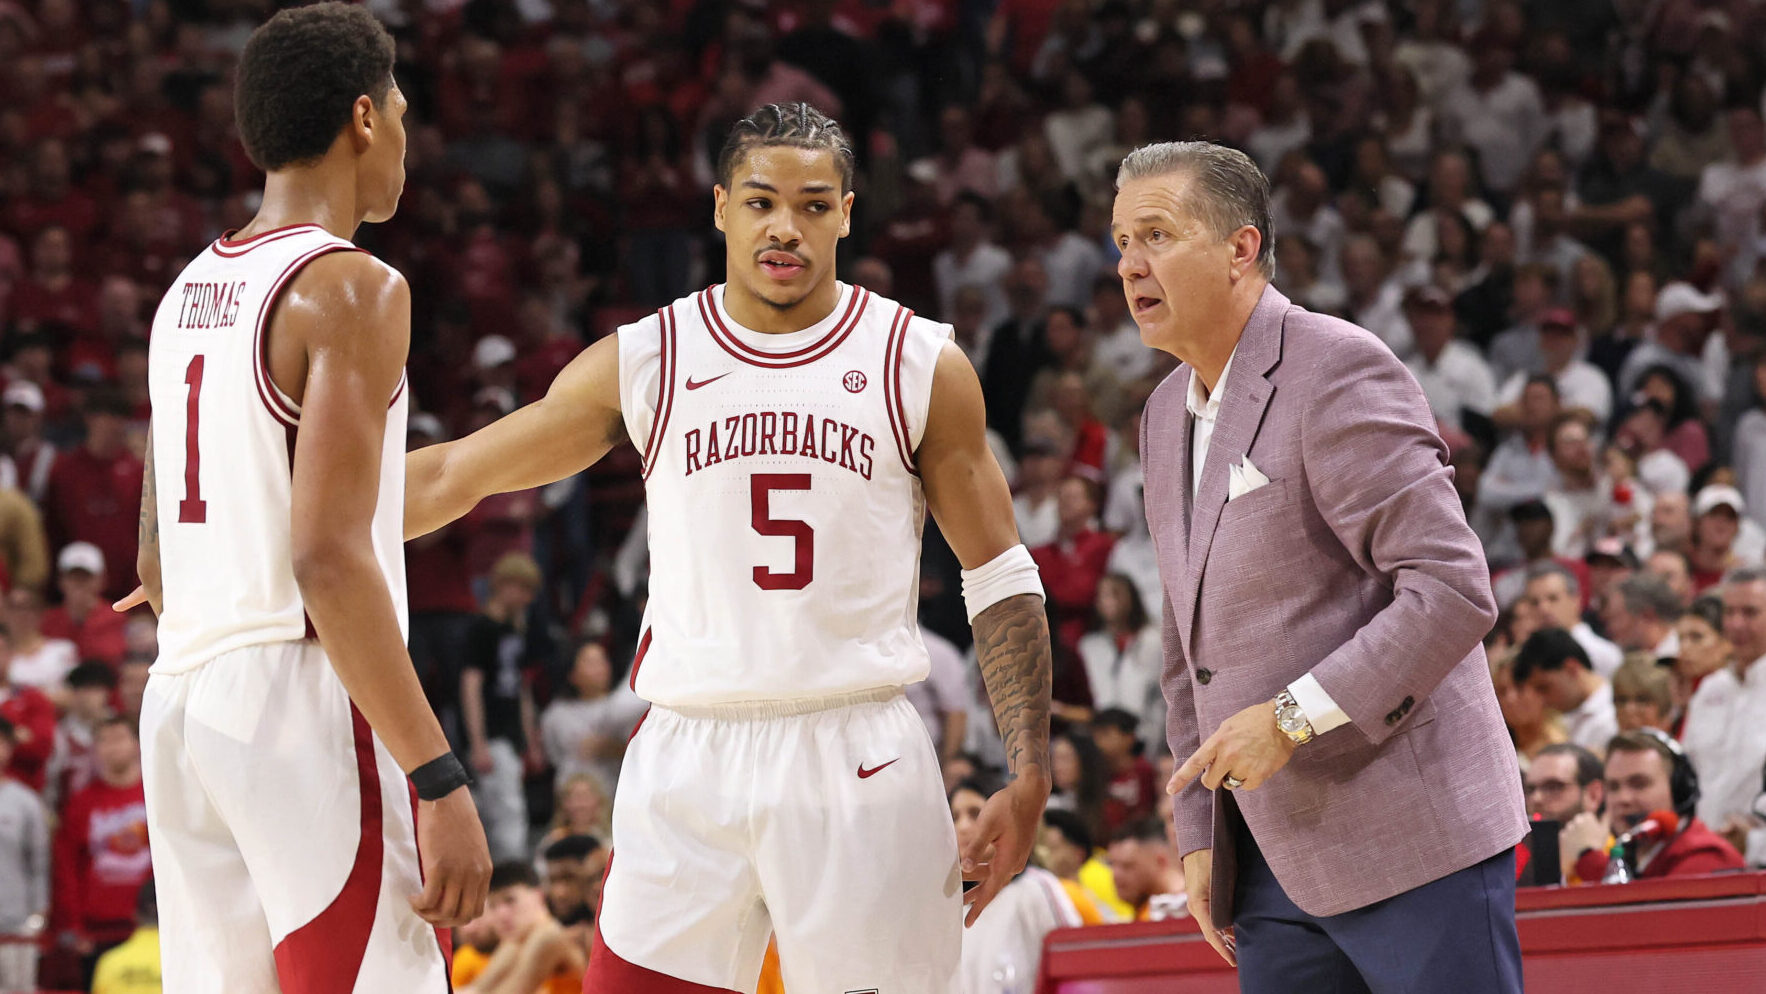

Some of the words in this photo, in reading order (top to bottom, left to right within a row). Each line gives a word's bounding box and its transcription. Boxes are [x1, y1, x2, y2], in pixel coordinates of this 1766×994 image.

[178, 281, 246, 329] THOMAS
[844, 371, 866, 392] SEC
[178, 354, 207, 523] 1
[685, 411, 875, 481] RAZORBACKS
[750, 473, 814, 590] 5
